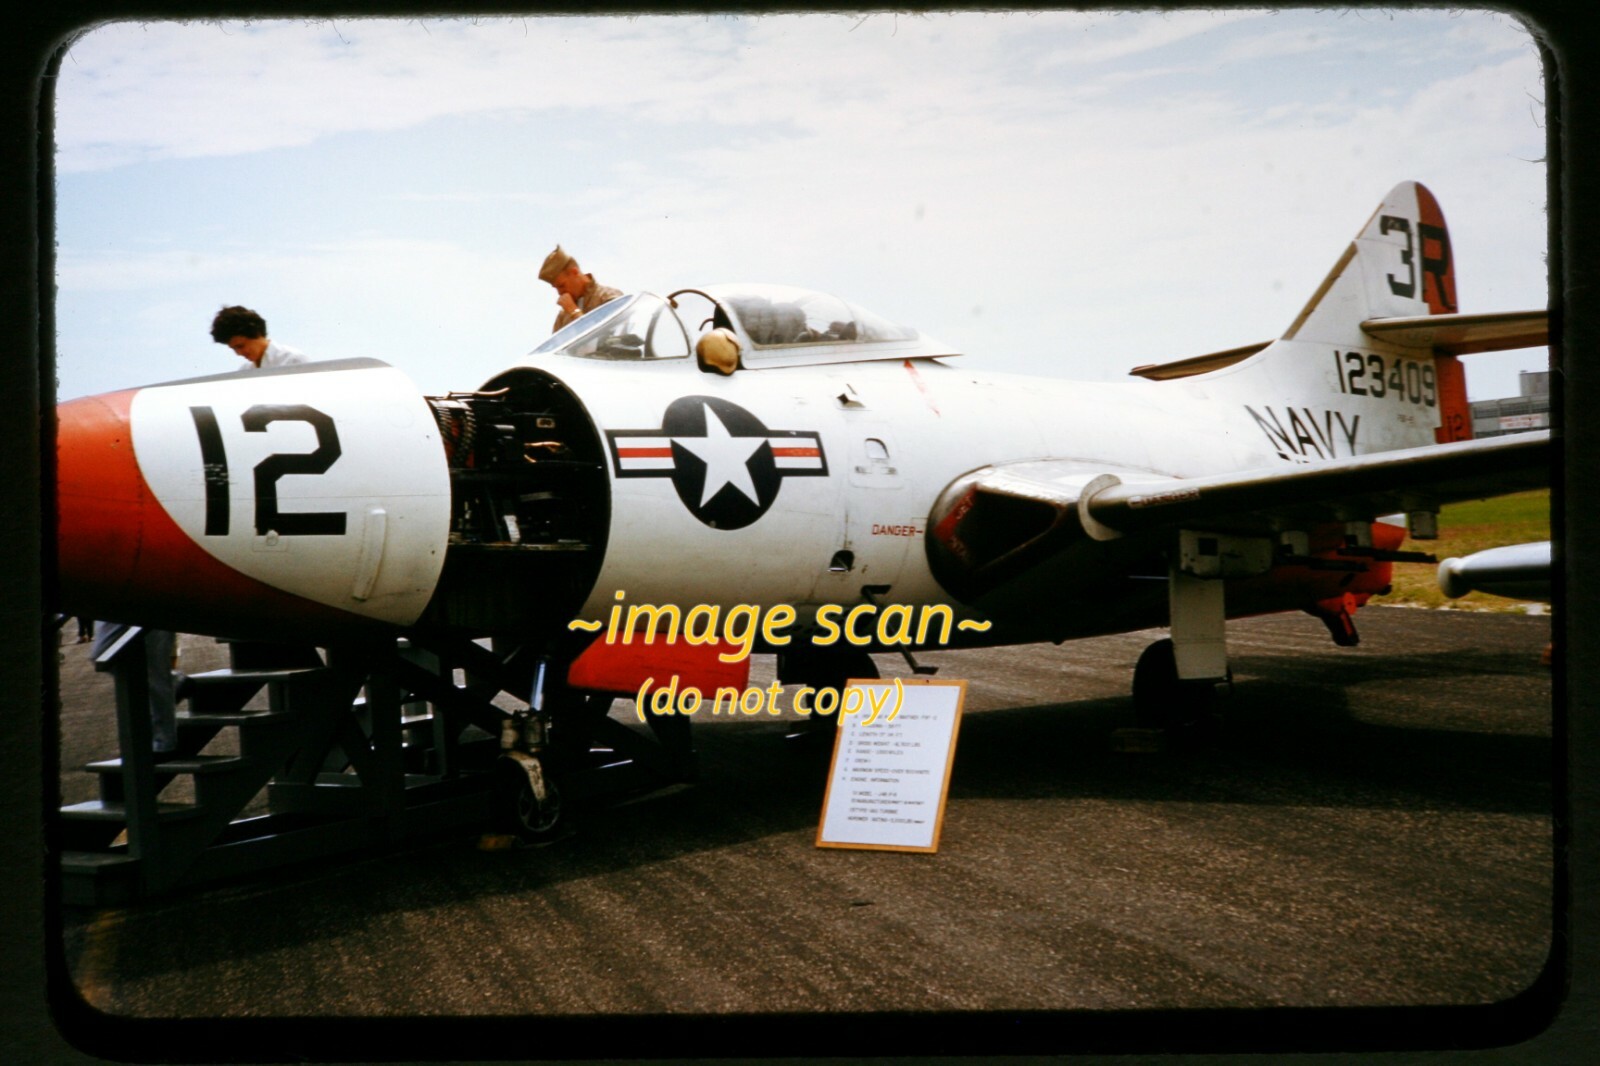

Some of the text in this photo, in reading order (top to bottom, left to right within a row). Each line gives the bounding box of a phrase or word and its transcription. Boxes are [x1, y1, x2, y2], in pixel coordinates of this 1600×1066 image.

[1334, 350, 1436, 407] 123409
[1244, 404, 1360, 463] NAVY
[189, 404, 347, 536] 12
